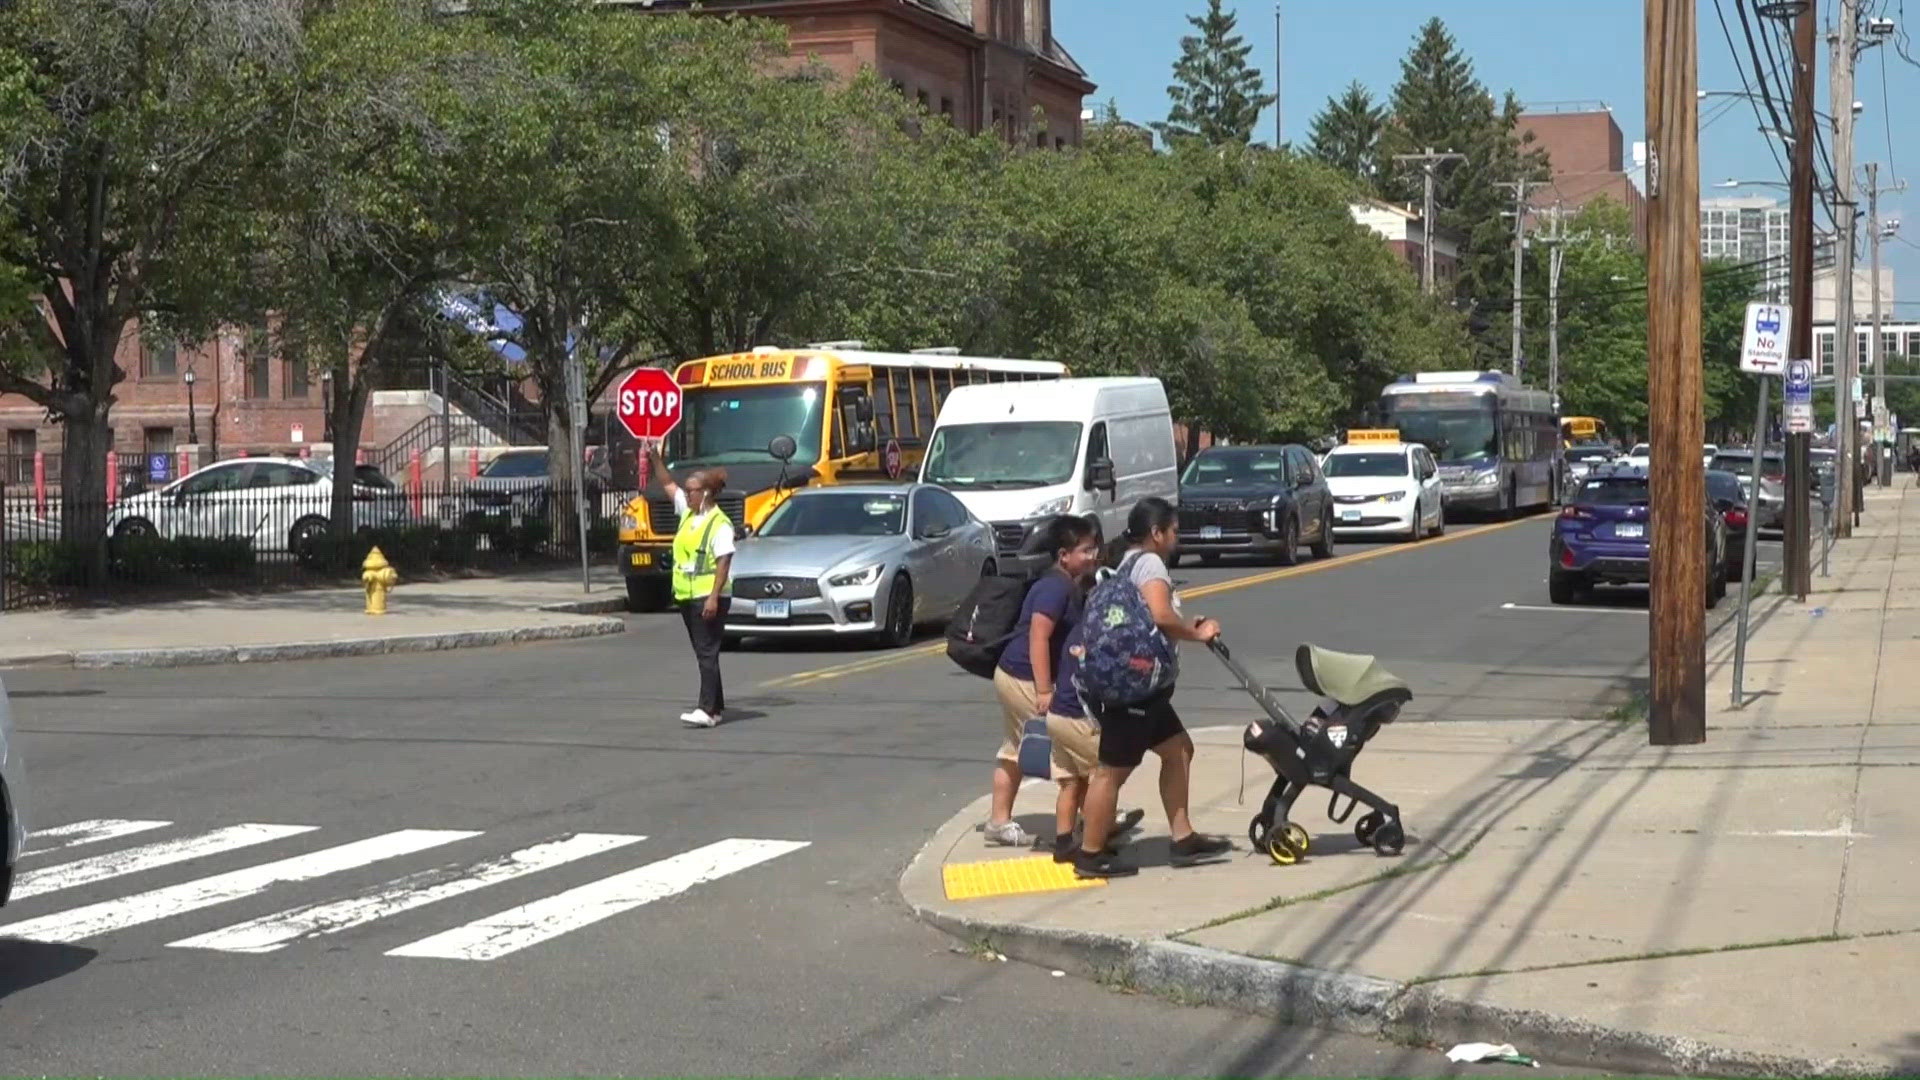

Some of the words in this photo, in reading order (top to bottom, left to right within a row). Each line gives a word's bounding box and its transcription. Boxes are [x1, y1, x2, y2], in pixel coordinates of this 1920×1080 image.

[1756, 335, 1775, 349] No
[1747, 349, 1782, 360] Standing
[710, 364, 758, 381] SCHOOL
[760, 362, 787, 377] BUS
[621, 389, 678, 417] STOP
